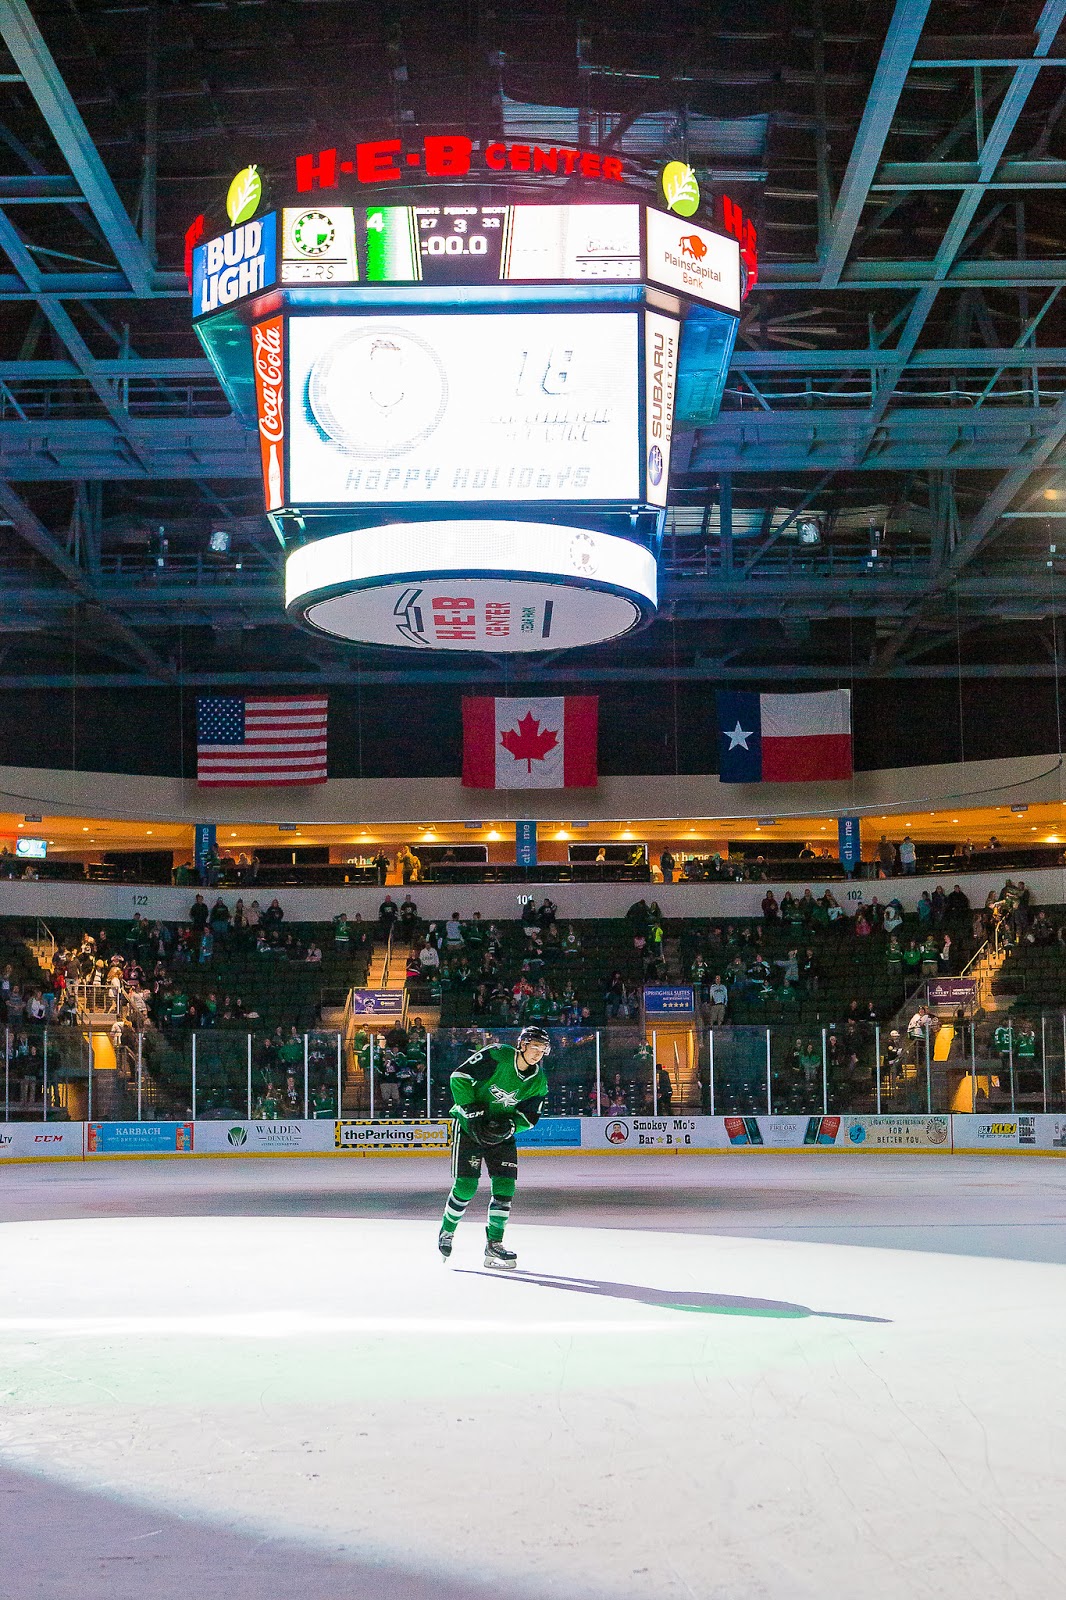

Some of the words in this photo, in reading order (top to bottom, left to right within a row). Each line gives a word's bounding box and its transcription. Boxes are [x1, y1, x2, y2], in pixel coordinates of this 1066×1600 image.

[485, 143, 624, 182] CENTER
[367, 213, 384, 232] 4
[421, 219, 438, 228] 27
[454, 220, 467, 233] 3
[207, 222, 264, 275] BUD
[664, 252, 721, 283] PlainsCapital
[201, 254, 266, 312] LIGHT
[682, 272, 704, 289] Bank
[653, 332, 664, 439] SUBARU
[666, 337, 674, 442] GEORGETOWN
[485, 601, 511, 637] CENTER
[521, 824, 531, 852] hme
[132, 895, 148, 906] 122
[847, 890, 863, 901] 102
[115, 1127, 161, 1136] KARBACH
[255, 1125, 302, 1135] WALDEN
[633, 1120, 668, 1132] Smokey
[673, 1120, 696, 1130] Mo's
[34, 1135, 63, 1143] CCM
[344, 1128, 446, 1142] theParkingSpot
[638, 1134, 655, 1145] Bar
[877, 1136, 903, 1144] BETTER
